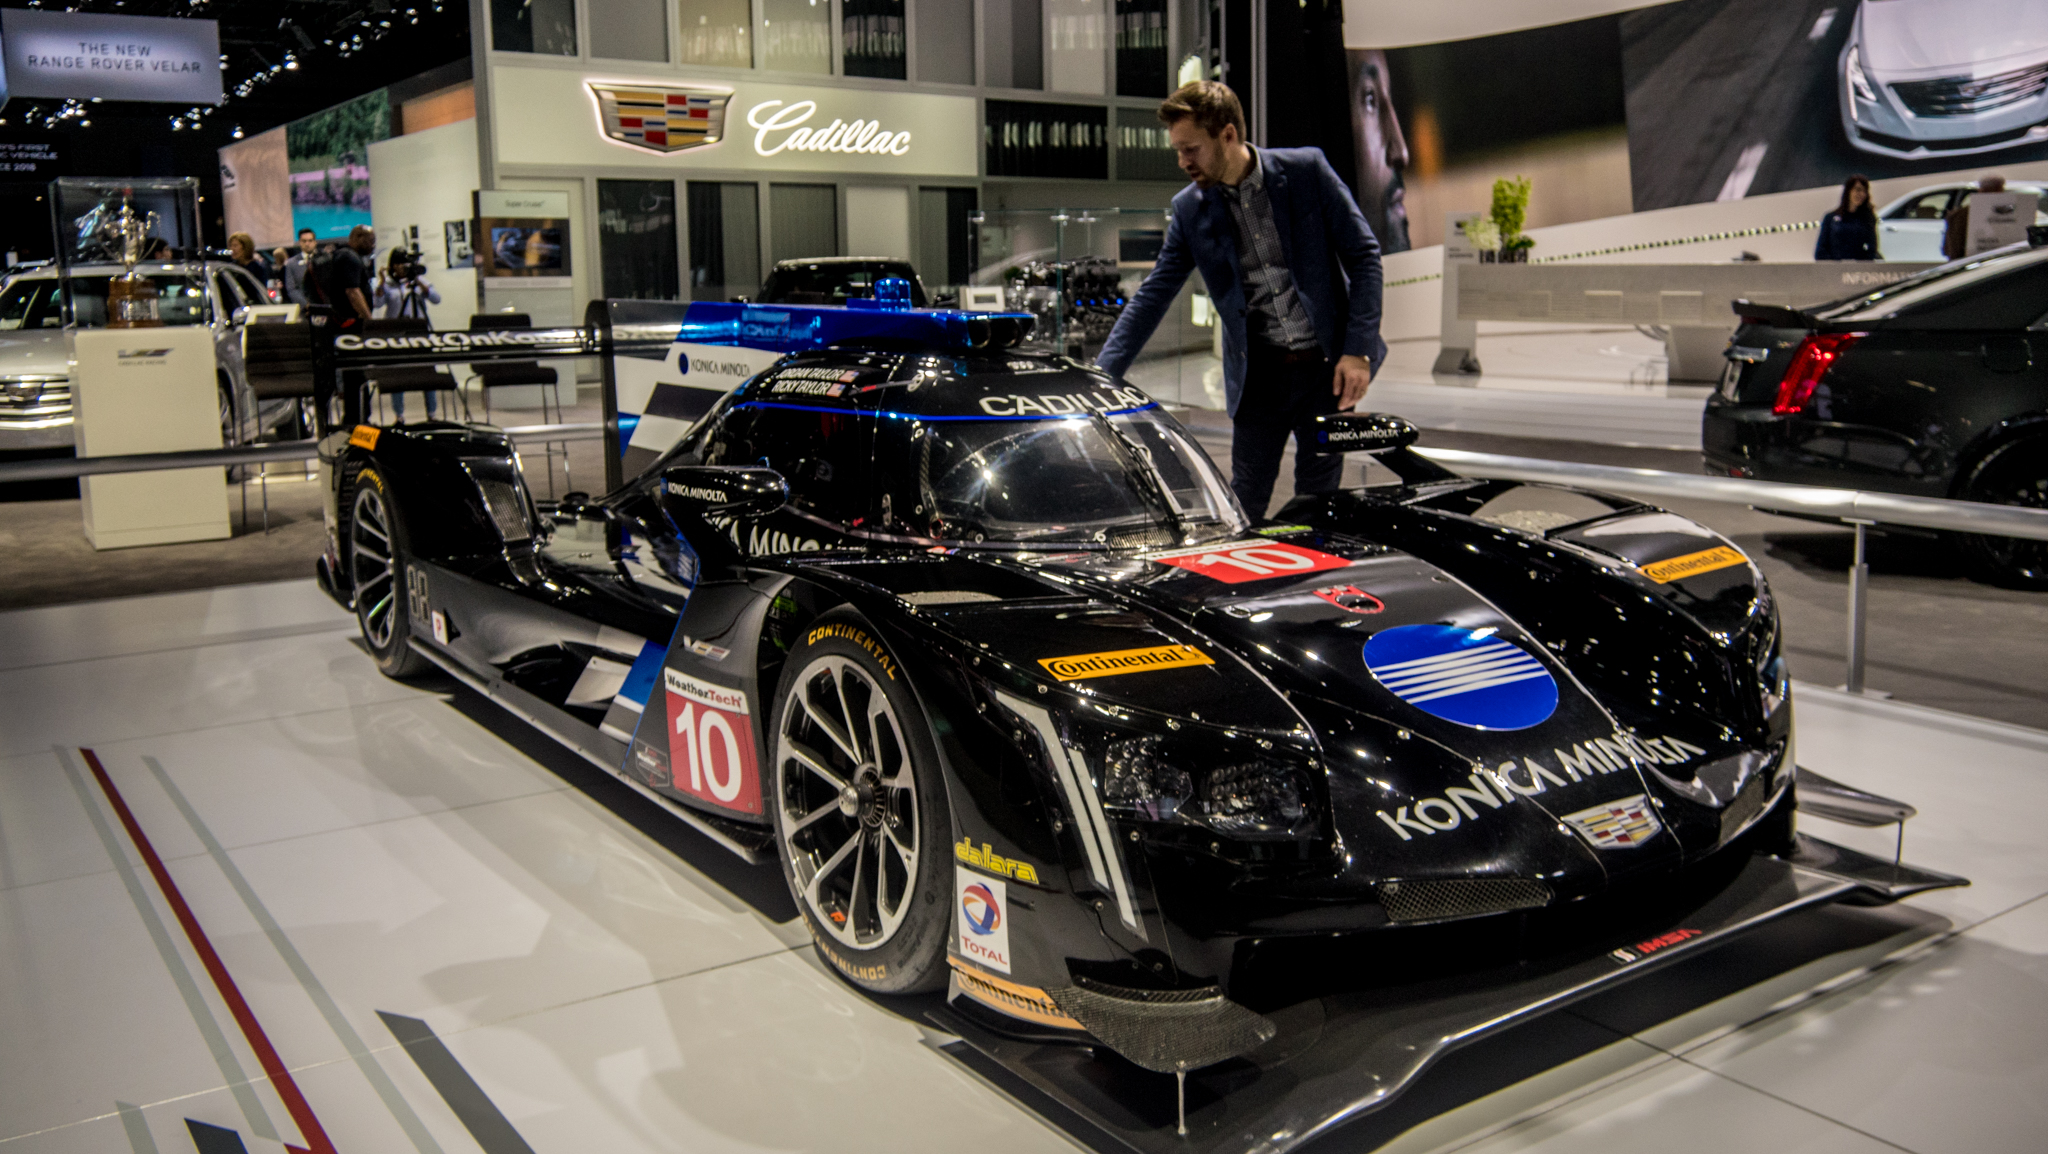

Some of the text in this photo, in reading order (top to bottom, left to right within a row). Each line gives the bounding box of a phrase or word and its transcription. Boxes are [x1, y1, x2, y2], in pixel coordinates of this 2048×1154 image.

[28, 54, 201, 74] RANGE ROVER VELAR
[78, 42, 151, 57] THE NEW
[747, 99, 912, 157] Cadillac
[690, 358, 719, 375] KONICA
[808, 369, 845, 381] TAYLOR
[771, 379, 832, 395] RICKY TAYLOR
[978, 386, 1149, 416] CADILLAC
[1328, 429, 1399, 442] KONICA MINOLTA
[667, 481, 728, 503] KONICA MINOLTA
[1197, 548, 1316, 576] 10
[1644, 549, 1728, 581] Continental
[807, 623, 897, 681] CONTINENTAL
[1047, 648, 1186, 678] Continental
[666, 674, 742, 708] WeatherTech
[675, 701, 742, 802] 10
[1375, 733, 1707, 841] KONICA MINOLTA
[955, 836, 1039, 885] dallara
